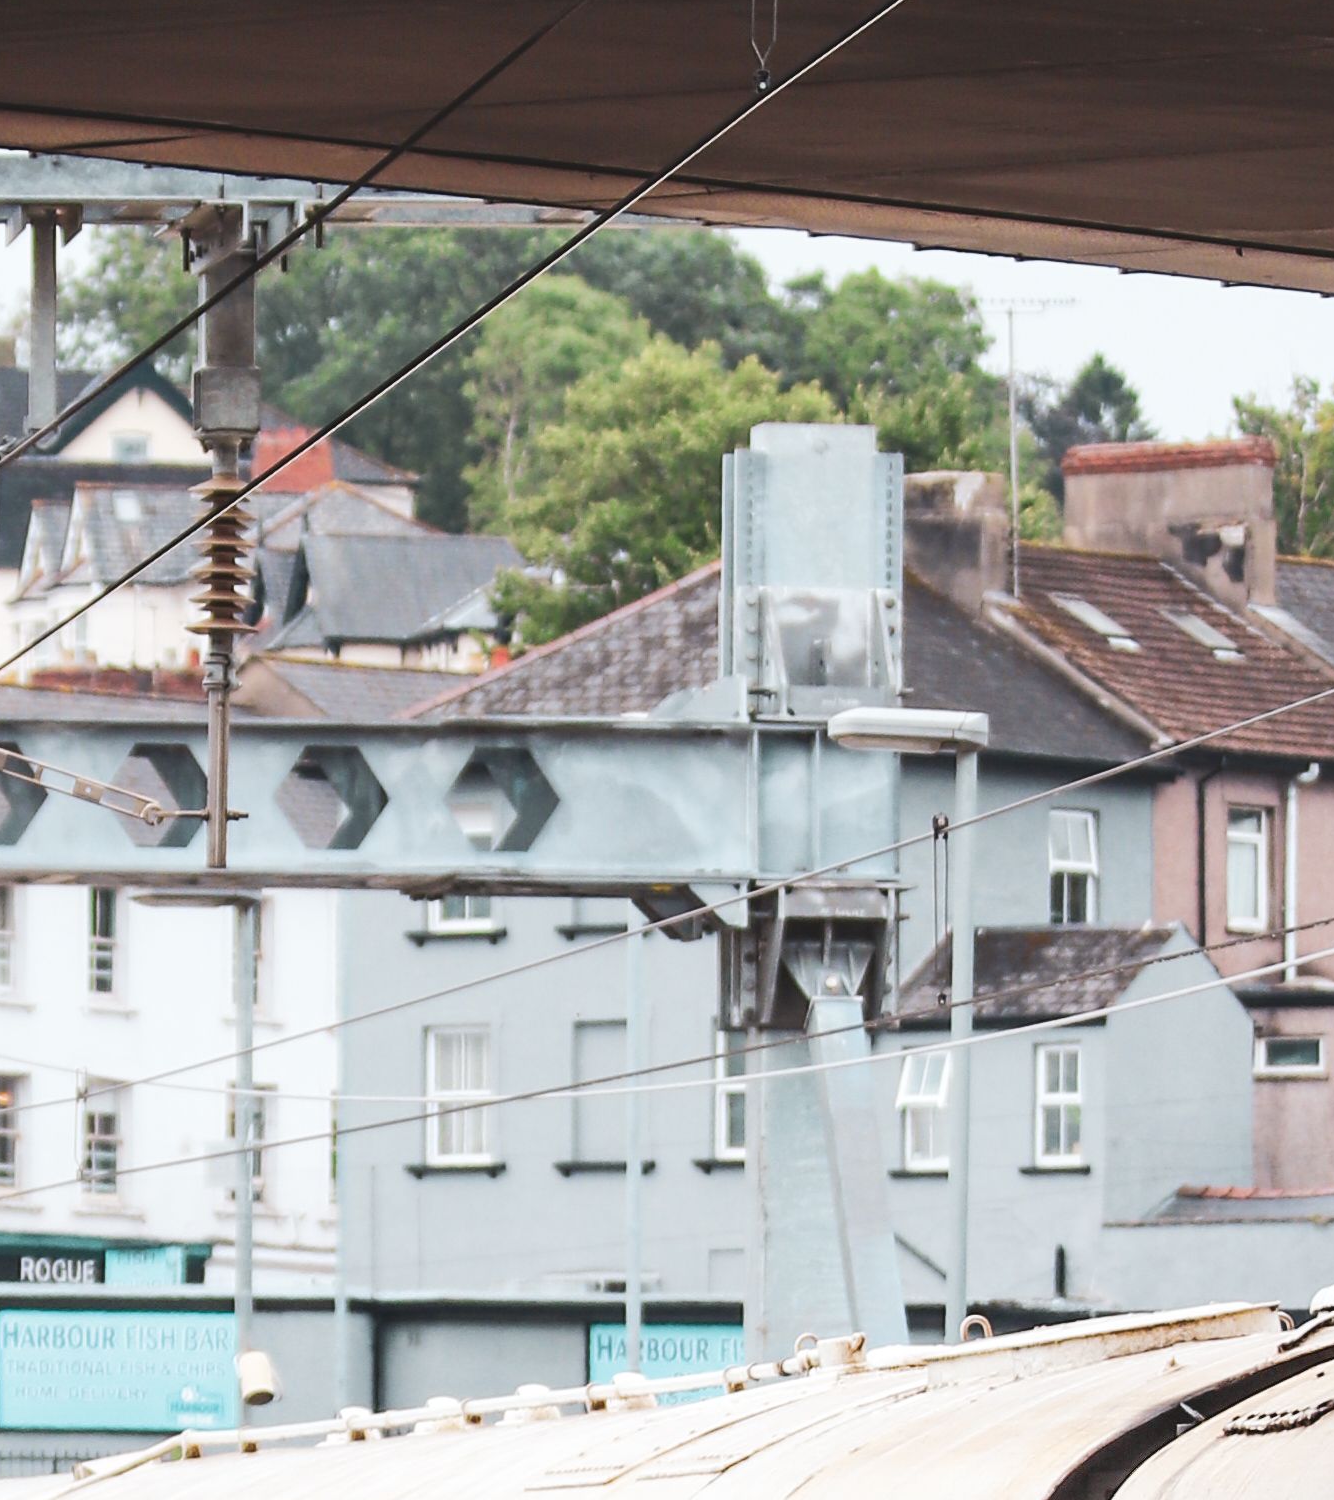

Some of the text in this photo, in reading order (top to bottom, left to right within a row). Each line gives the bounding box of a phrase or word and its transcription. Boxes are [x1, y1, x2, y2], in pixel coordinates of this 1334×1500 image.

[20, 1256, 96, 1284] ROGUE
[2, 1323, 229, 1350] HARBOUR FISH BAR
